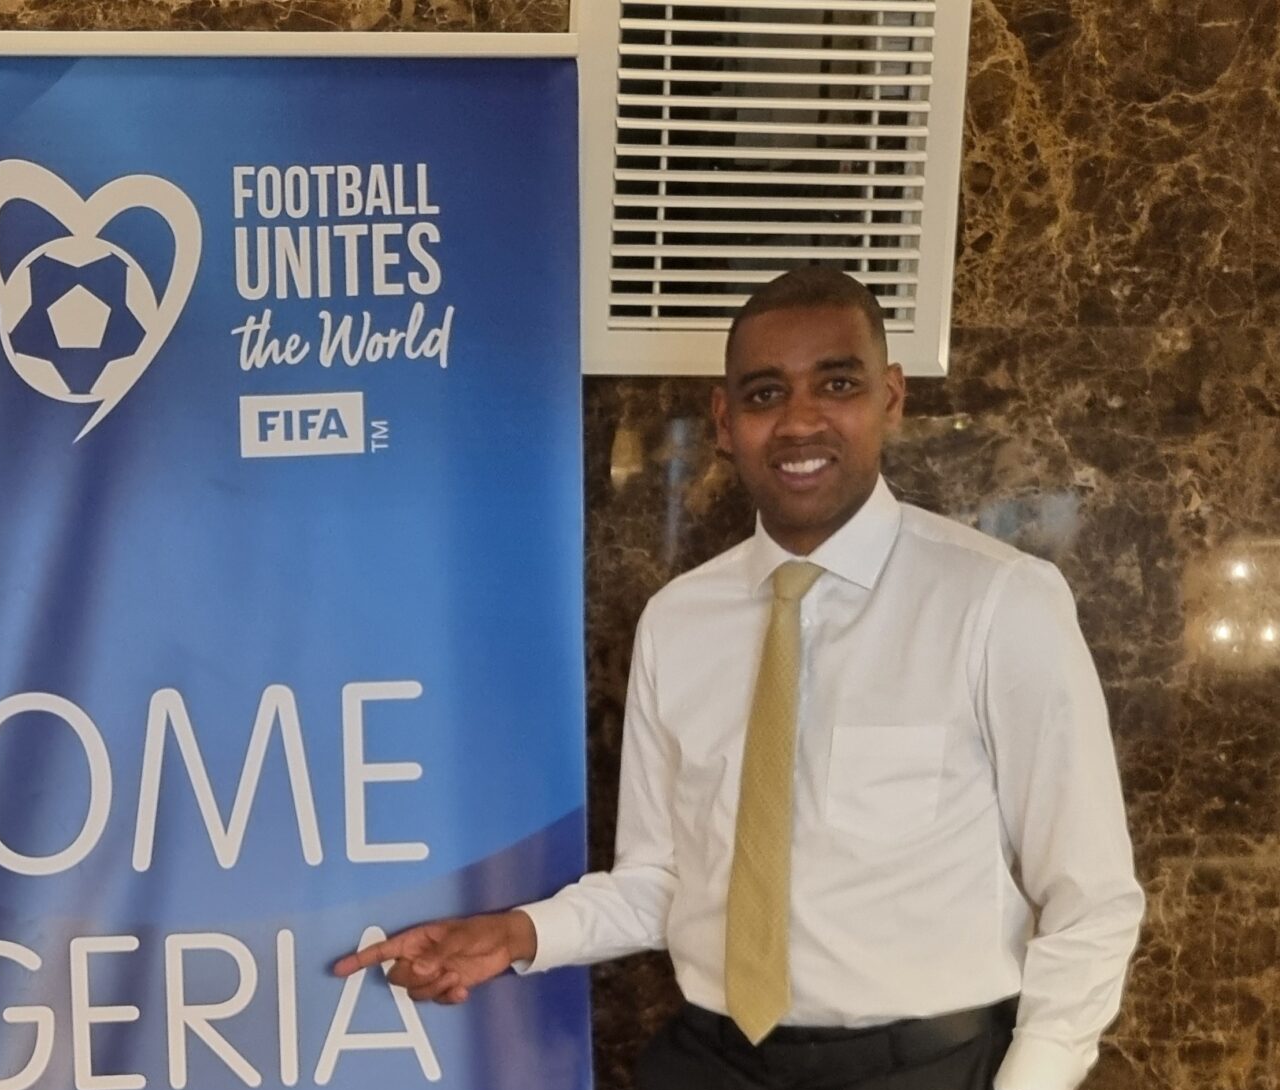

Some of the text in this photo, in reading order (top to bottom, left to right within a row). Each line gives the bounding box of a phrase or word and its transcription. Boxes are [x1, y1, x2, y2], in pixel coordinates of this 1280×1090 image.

[232, 162, 440, 219] FOOTBALL
[234, 221, 442, 300] UNITES
[231, 302, 455, 371] the World
[256, 407, 349, 443] FIFA
